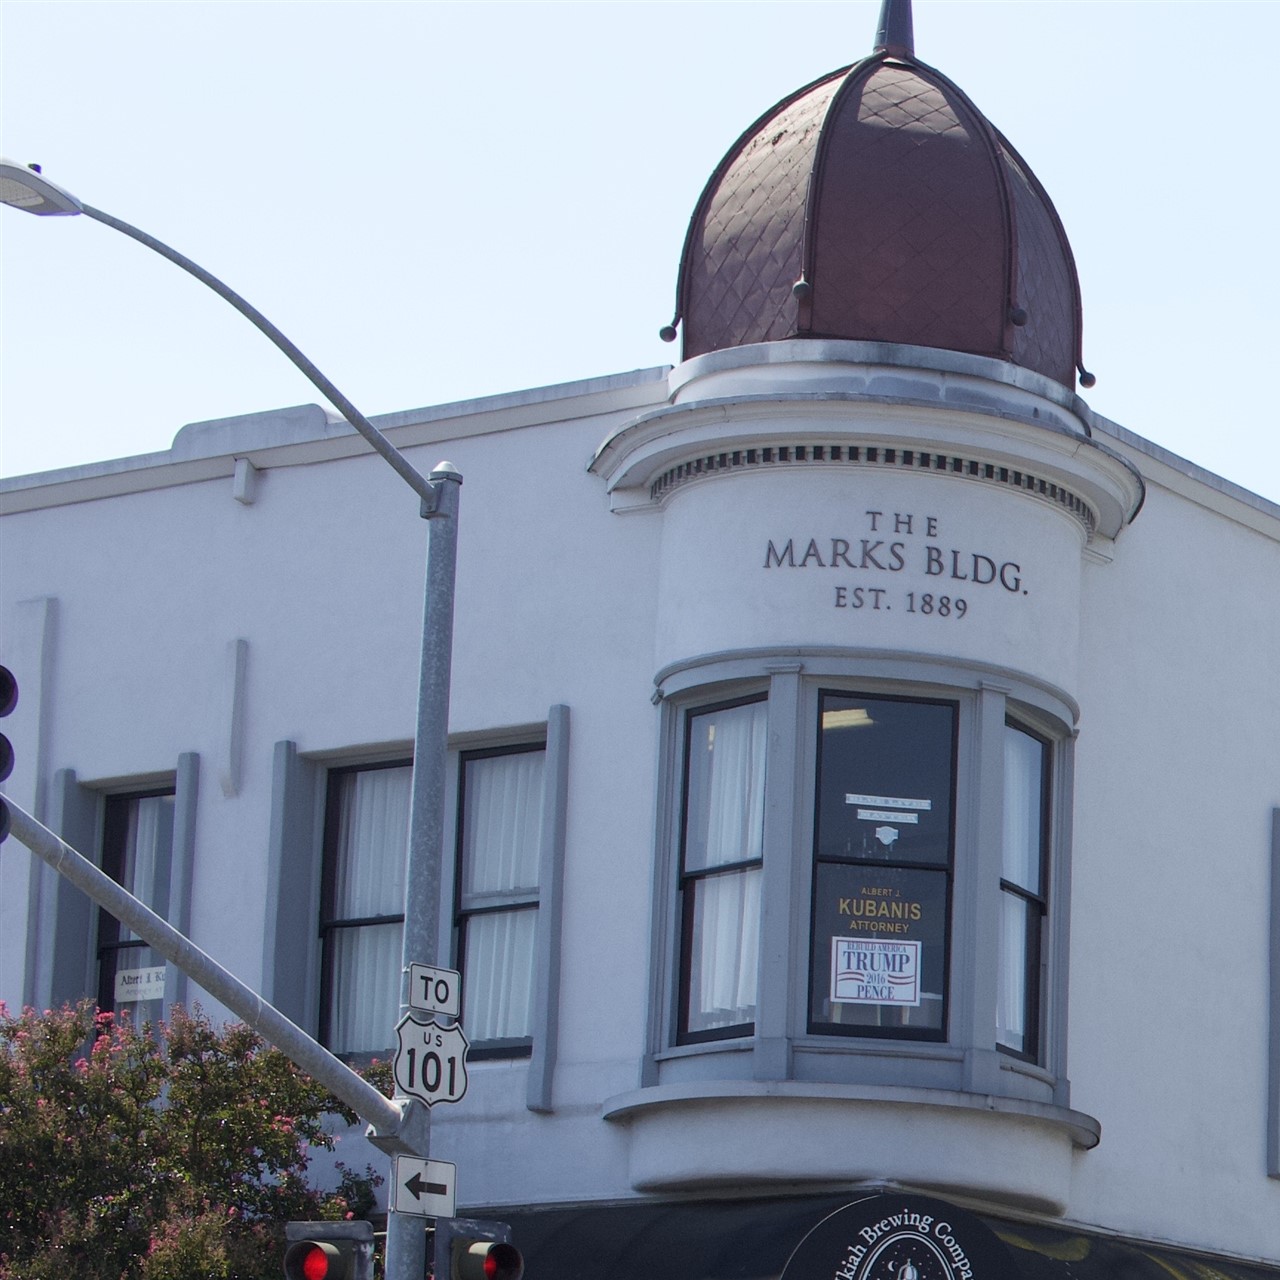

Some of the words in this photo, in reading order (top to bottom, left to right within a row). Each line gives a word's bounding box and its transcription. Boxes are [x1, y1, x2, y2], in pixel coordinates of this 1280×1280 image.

[866, 511, 938, 537] THE
[763, 538, 905, 572] MARKS
[925, 546, 1028, 595] BLDG.
[834, 587, 891, 610] EST.
[906, 592, 968, 619] 1889
[861, 887, 893, 897] ALBERT
[839, 898, 922, 920] KUBANIS
[849, 920, 910, 933] ATTORNEY
[847, 941, 877, 952] REBUILD
[877, 944, 907, 954] AMERICA
[843, 951, 911, 973] TRUMP
[420, 975, 449, 1004] TO
[866, 972, 886, 985] 2016
[857, 984, 895, 1000] PENCE
[423, 1031, 443, 1047] US
[407, 1048, 456, 1097] 101
[858, 1208, 934, 1246] Brewing
